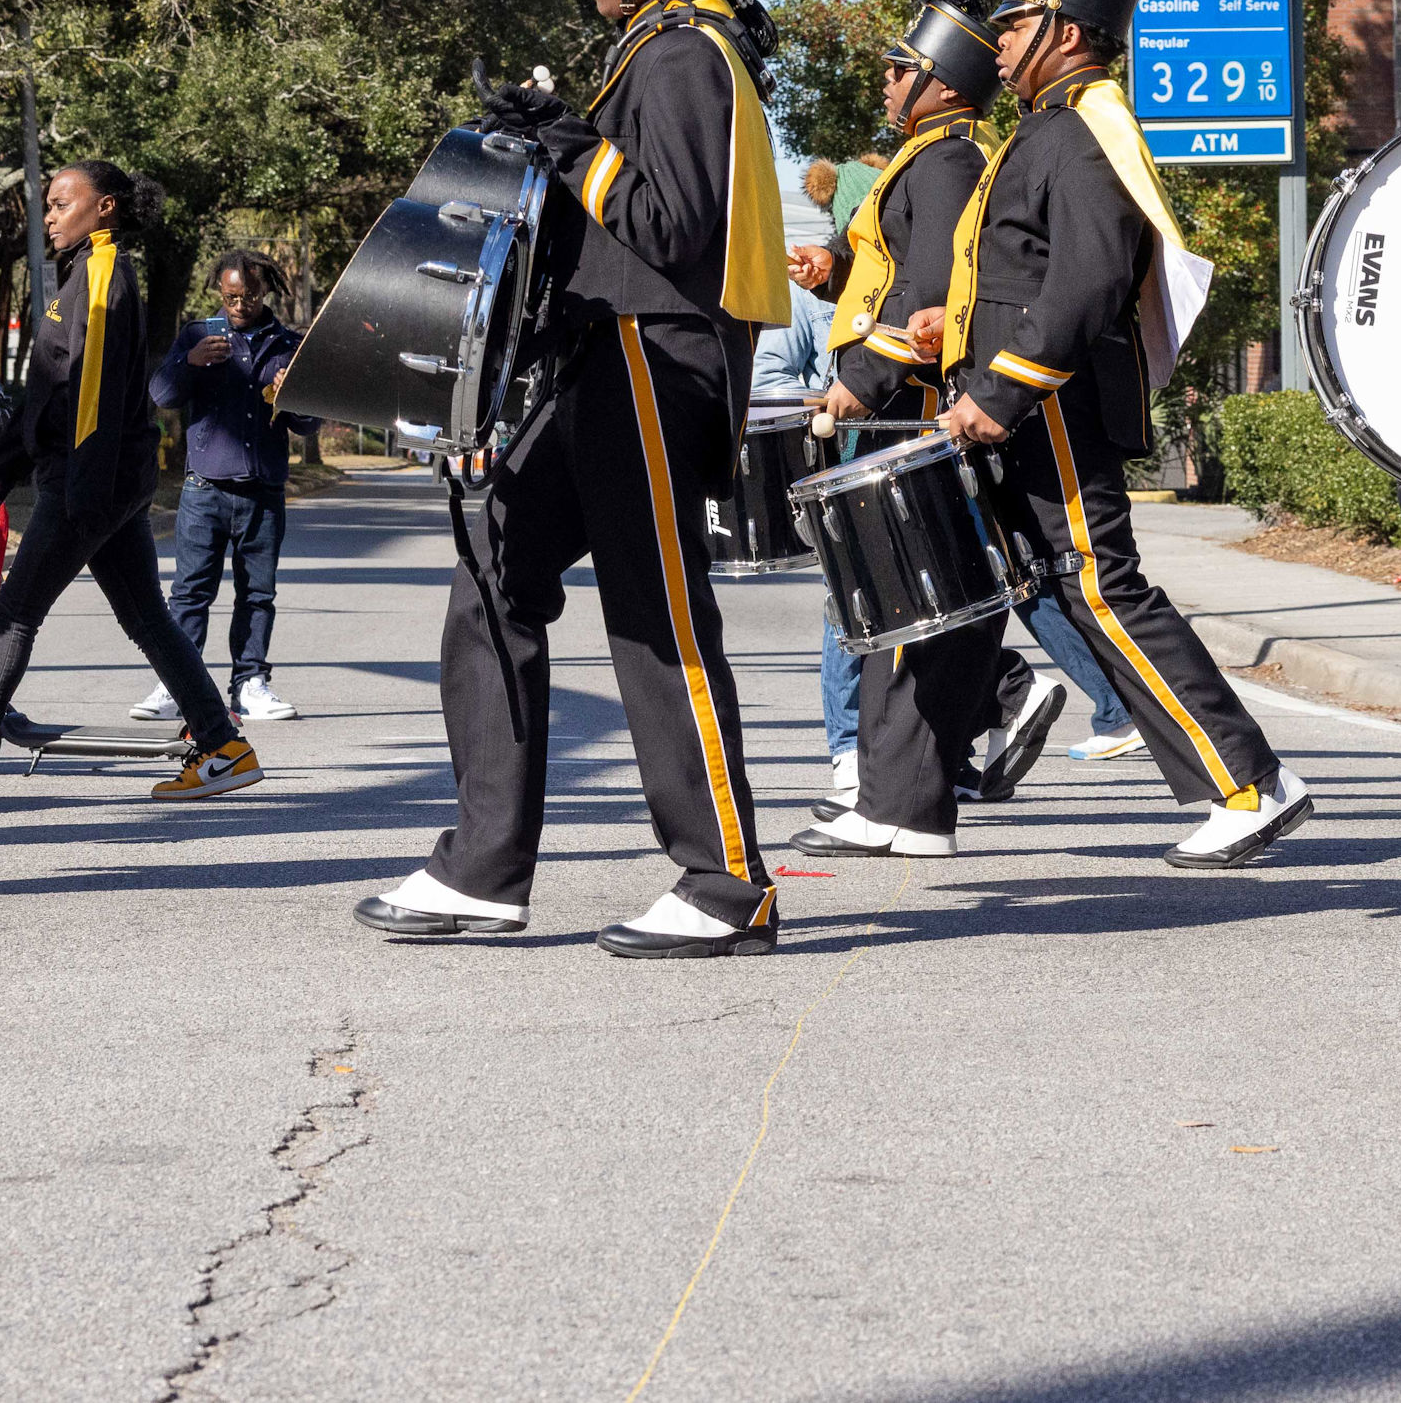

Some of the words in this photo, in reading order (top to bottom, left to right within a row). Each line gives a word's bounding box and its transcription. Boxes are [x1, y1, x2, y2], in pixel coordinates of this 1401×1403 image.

[1219, 0, 1242, 12] Self
[1245, 0, 1280, 12] Serve
[1139, 36, 1190, 51] Regular
[1190, 133, 1239, 153] ATM
[1355, 232, 1386, 327] EVANS
[1344, 300, 1354, 324] MX2
[709, 499, 732, 537] arl
